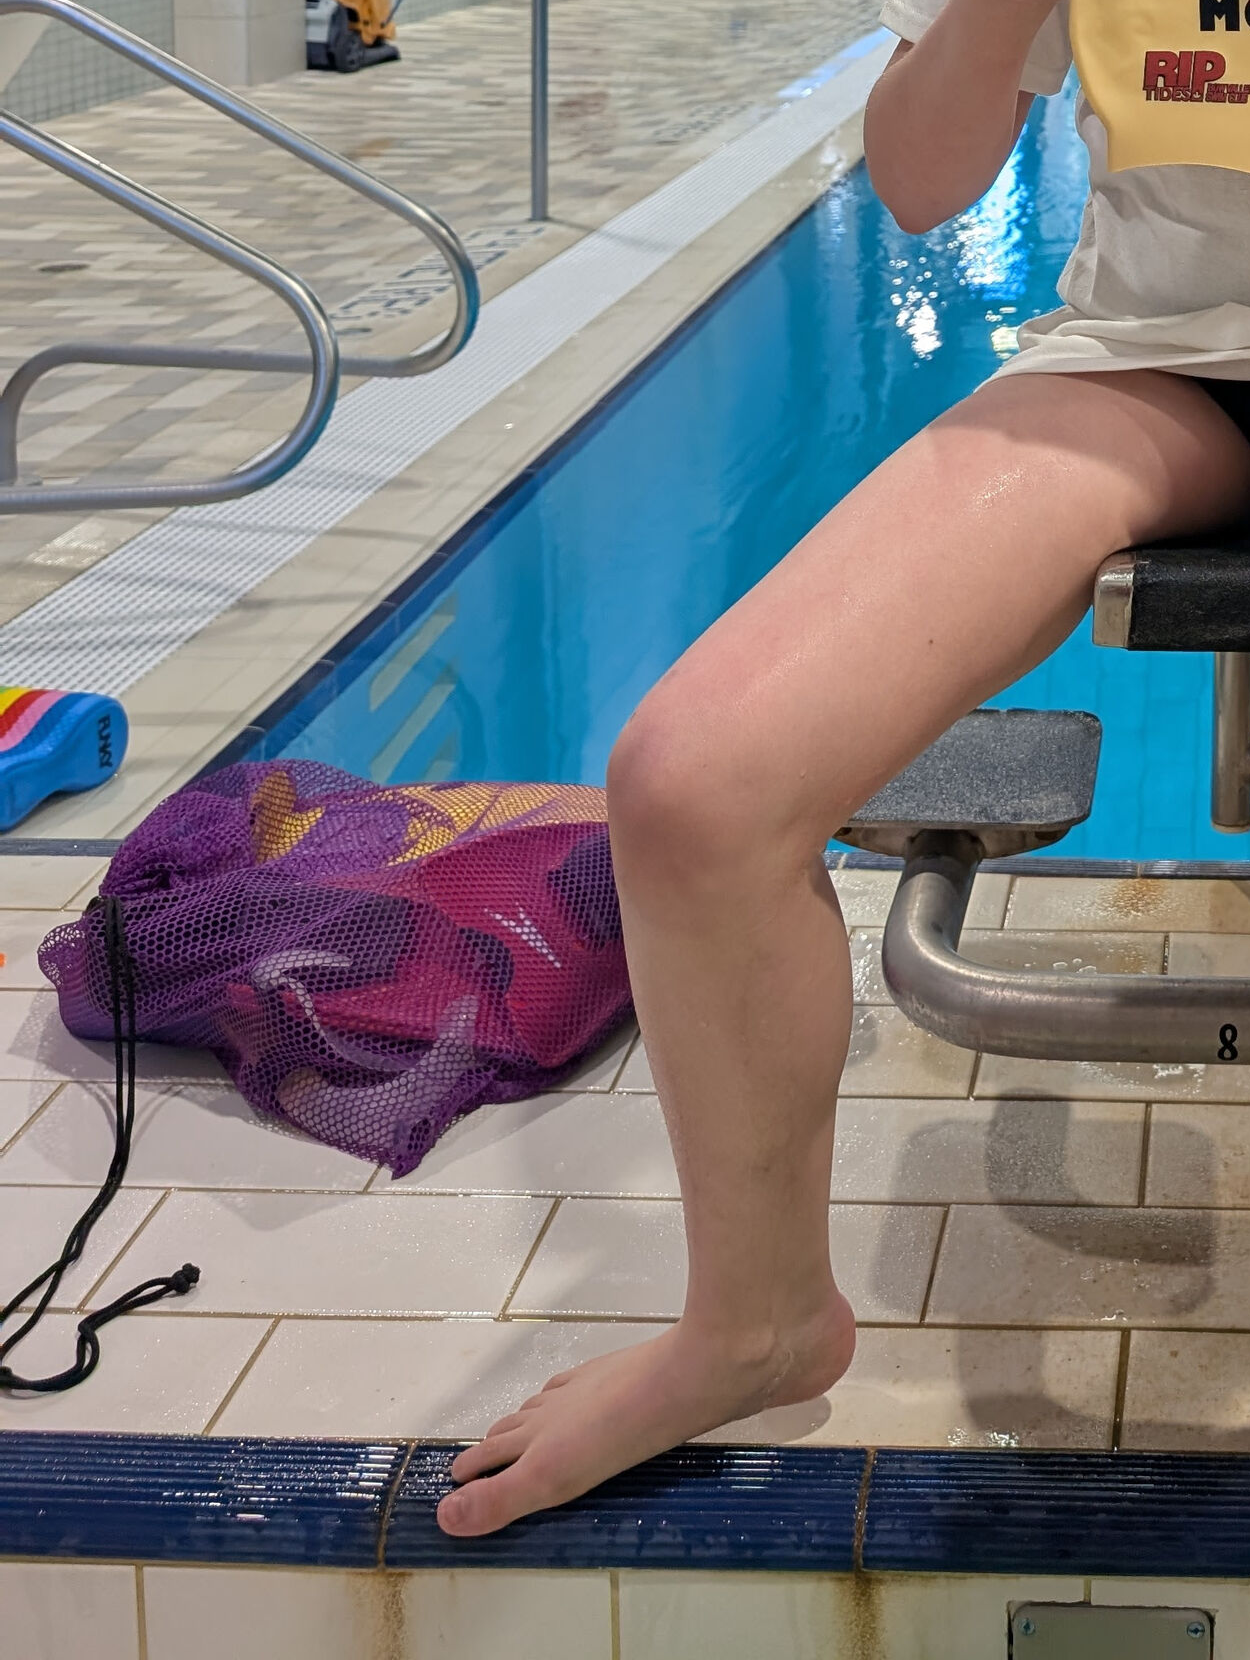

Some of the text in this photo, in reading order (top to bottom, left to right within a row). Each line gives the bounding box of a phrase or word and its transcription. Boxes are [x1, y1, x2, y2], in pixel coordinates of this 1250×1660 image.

[1143, 51, 1226, 102] RIP
[1144, 87, 1192, 103] TIDES
[1216, 1022, 1239, 1061] 8
